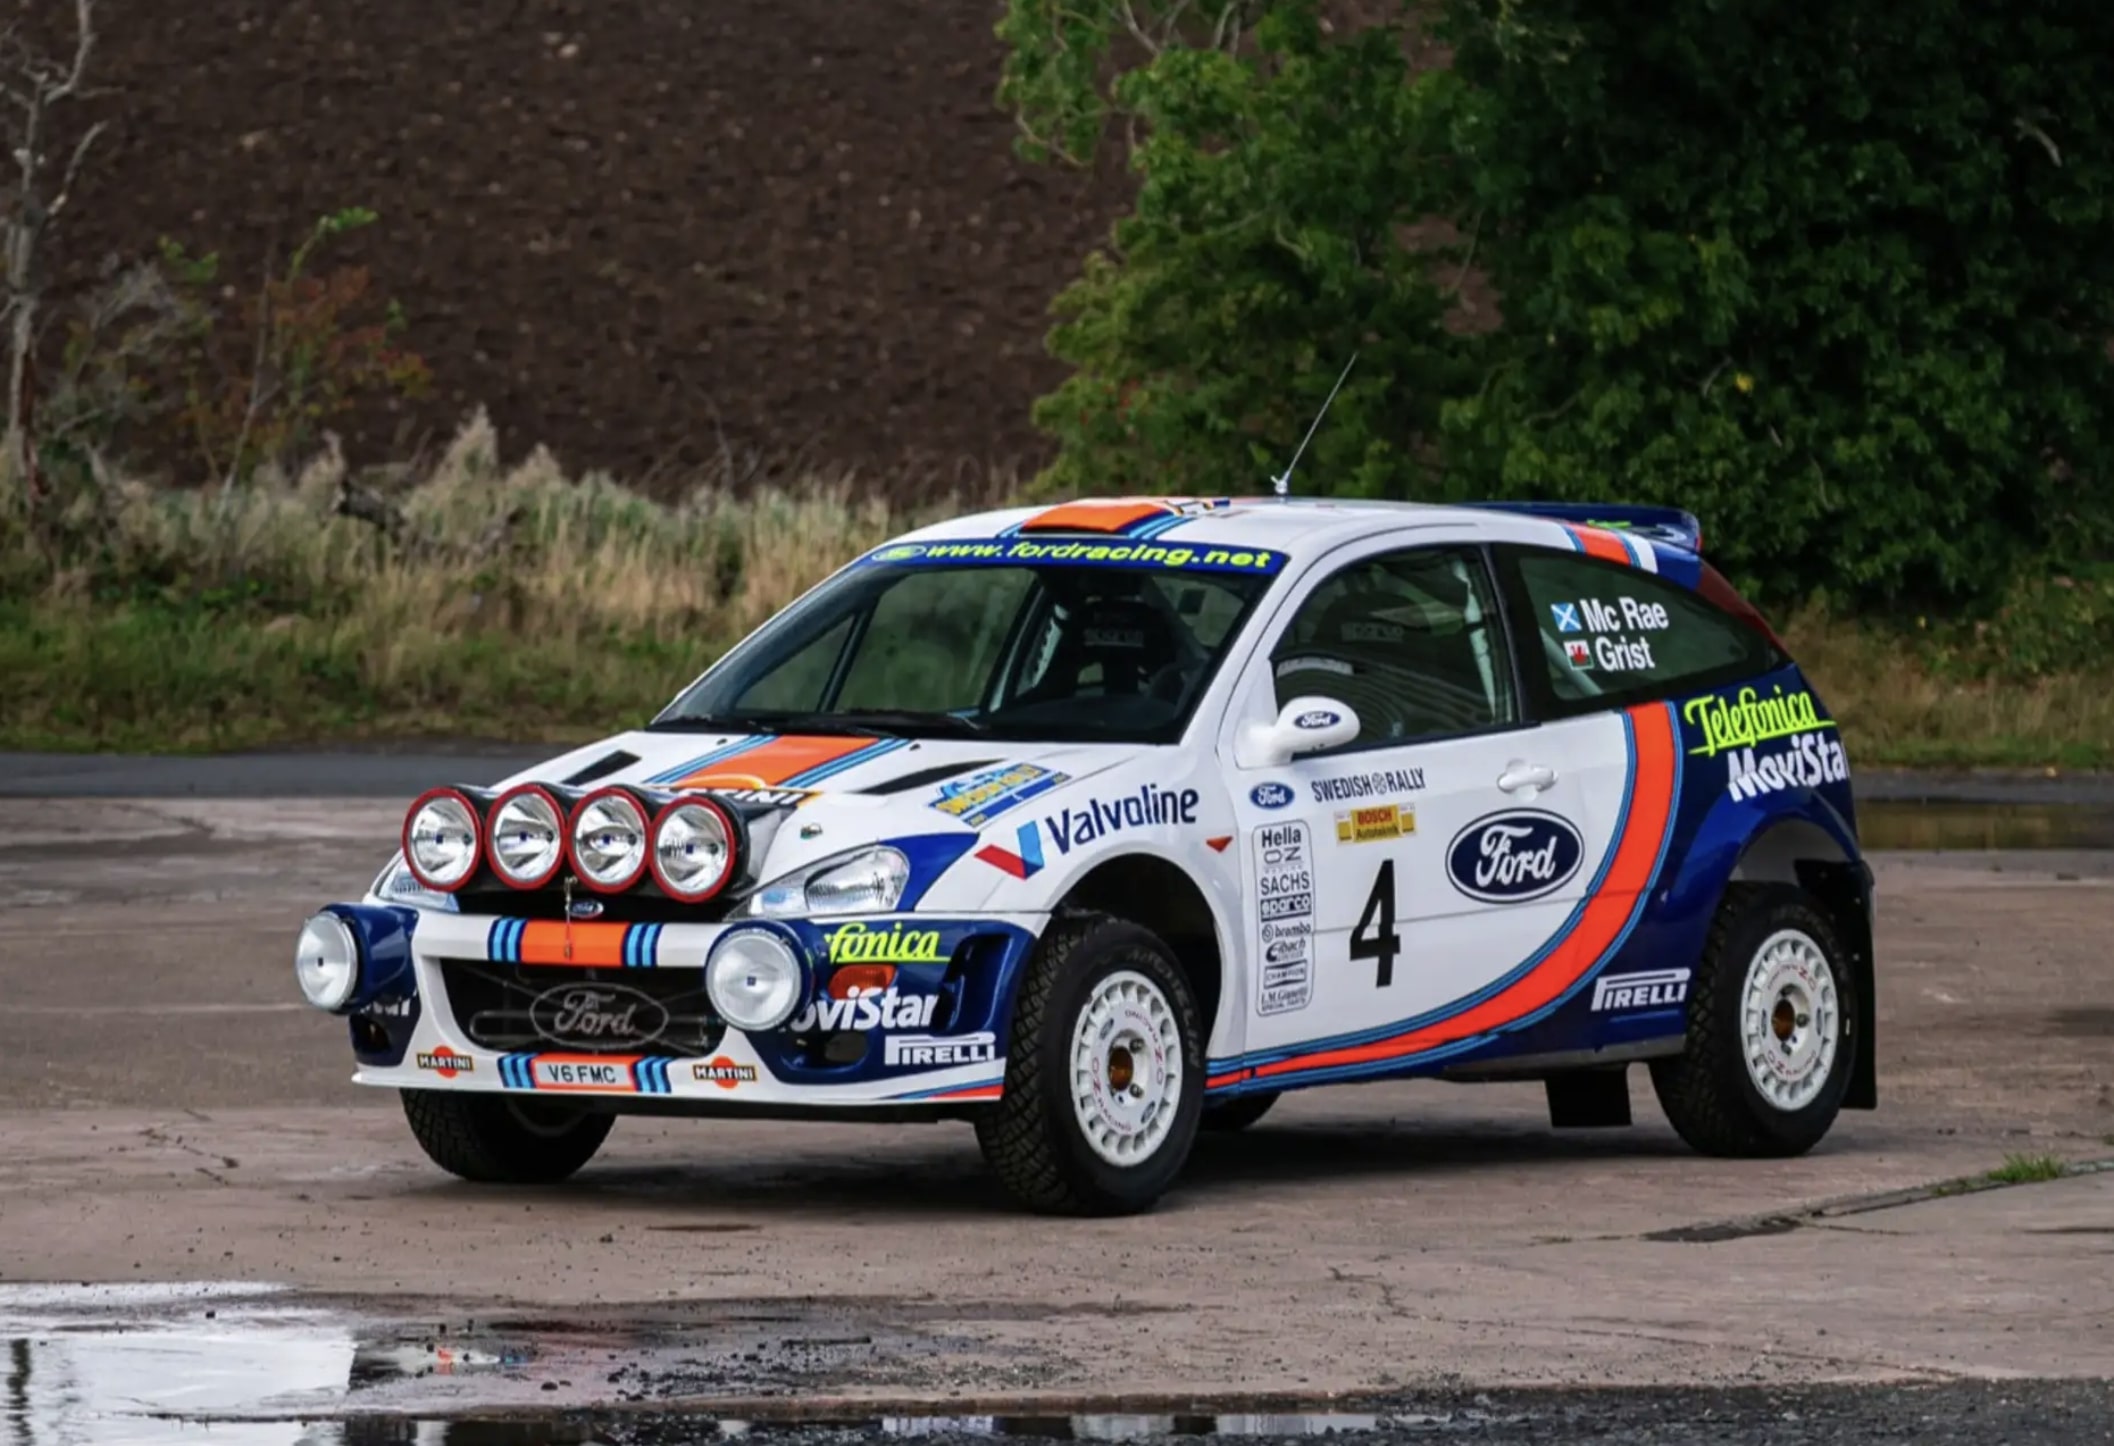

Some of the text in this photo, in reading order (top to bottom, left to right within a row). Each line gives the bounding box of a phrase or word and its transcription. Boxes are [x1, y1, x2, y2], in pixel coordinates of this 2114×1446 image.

[926, 541, 1271, 568] www.fordracing.net
[1580, 597, 1669, 633] Mc Rae
[1595, 636, 1655, 671] Grist
[1300, 711, 1332, 728] Ford
[1727, 731, 1850, 802] MoviSta
[1256, 785, 1287, 806] Ford
[1311, 768, 1426, 803] SWEDISH RALLY
[1046, 784, 1200, 855] Valvoline
[1358, 808, 1392, 826] BOSCH
[1261, 826, 1301, 848] Hella
[1474, 824, 1556, 887] Ford
[1260, 871, 1310, 896] SACHS
[1275, 921, 1311, 938] brembo
[1350, 858, 1401, 988] 4
[1591, 967, 1691, 1012] PIRELLI
[553, 989, 637, 1037] Ford
[786, 985, 939, 1032] oviStar
[418, 1056, 471, 1070] MARTINI
[884, 1032, 996, 1066] PIRELLI
[548, 1064, 617, 1085] V6 FMC
[695, 1066, 756, 1081] MARTINI
